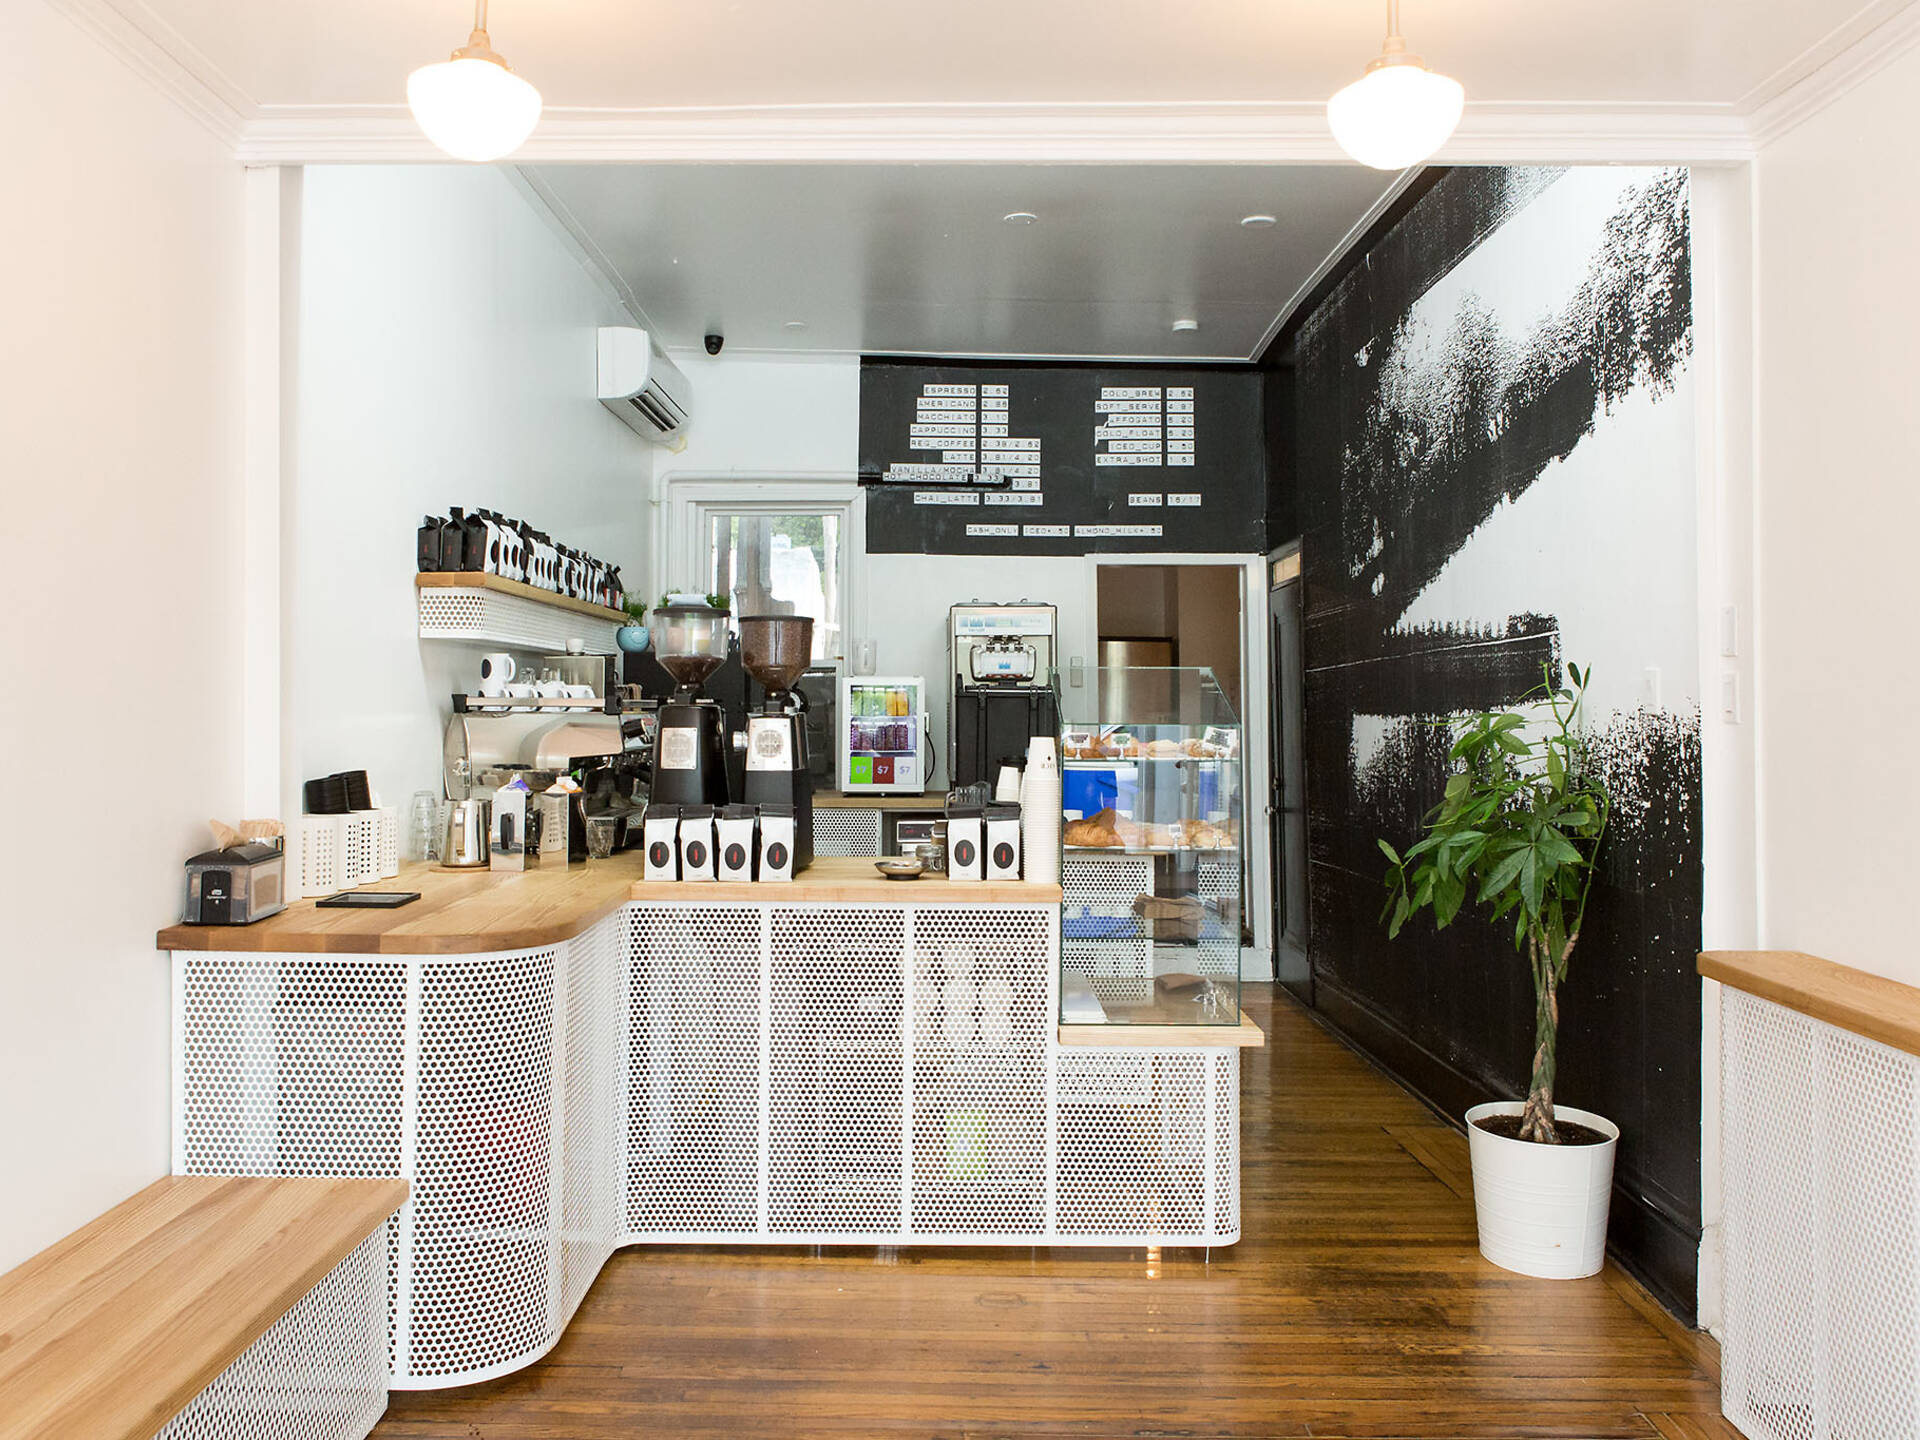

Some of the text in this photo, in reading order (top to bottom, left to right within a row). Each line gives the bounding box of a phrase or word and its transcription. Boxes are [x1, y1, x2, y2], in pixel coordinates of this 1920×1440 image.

[924, 386, 976, 395] ESPRESSO
[918, 400, 976, 408] AMERICANO
[917, 413, 976, 421] MACCHIATO
[1109, 416, 1161, 424] AFFOGATO
[911, 426, 976, 434] CAPPUCCINO
[944, 453, 975, 461] LATTE
[1129, 496, 1162, 504] BEANS
[877, 765, 889, 775] $7
[899, 765, 911, 775] $7
